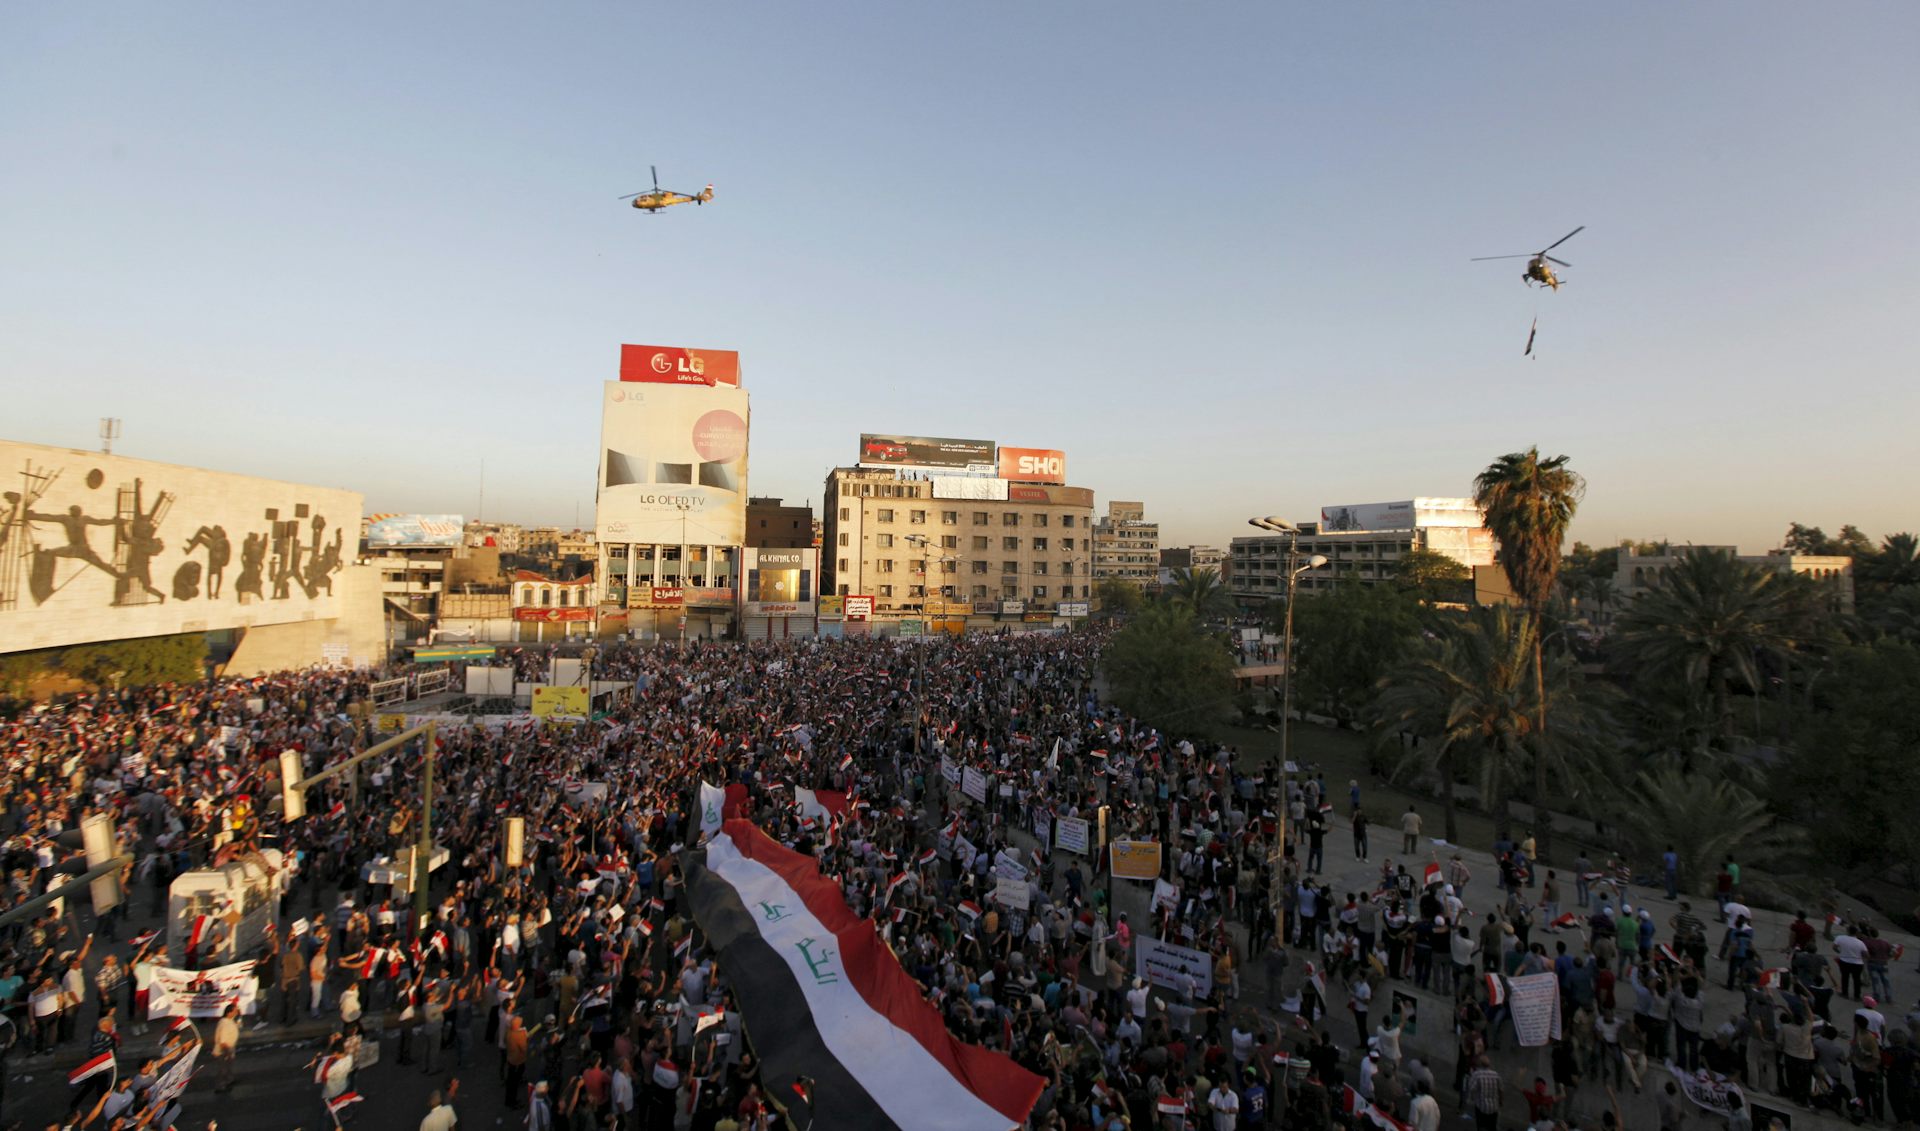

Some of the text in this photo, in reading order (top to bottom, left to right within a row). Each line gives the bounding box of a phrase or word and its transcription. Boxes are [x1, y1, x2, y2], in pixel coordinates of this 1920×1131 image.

[678, 357, 705, 375] LG
[628, 391, 645, 401] LG
[640, 495, 705, 506] LG OLED TV
[791, 554, 801, 563] CO.
